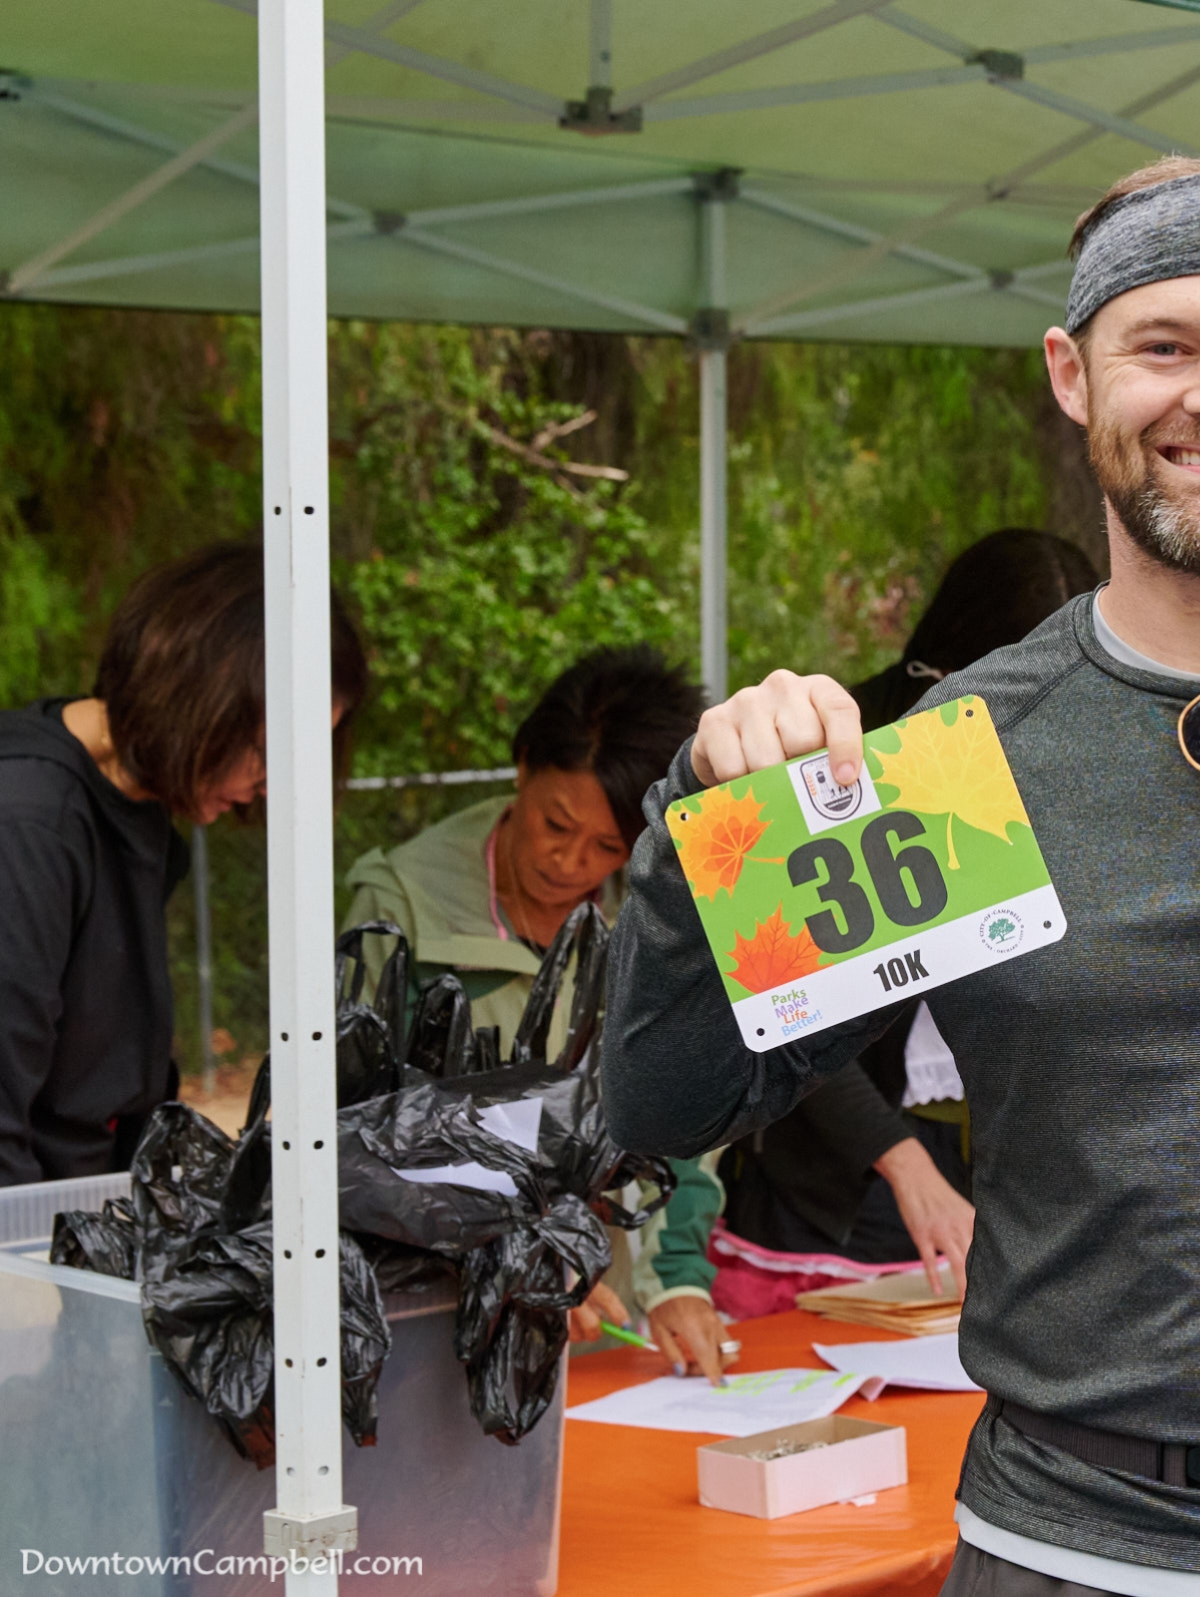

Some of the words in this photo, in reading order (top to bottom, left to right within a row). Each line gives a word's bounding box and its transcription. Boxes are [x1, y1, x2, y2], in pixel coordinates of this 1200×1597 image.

[786, 810, 949, 955] 36
[872, 949, 930, 993] 10K
[771, 989, 807, 1006] Parks
[775, 997, 809, 1019] Make
[781, 1009, 823, 1036] Better!
[783, 1009, 808, 1024] Life
